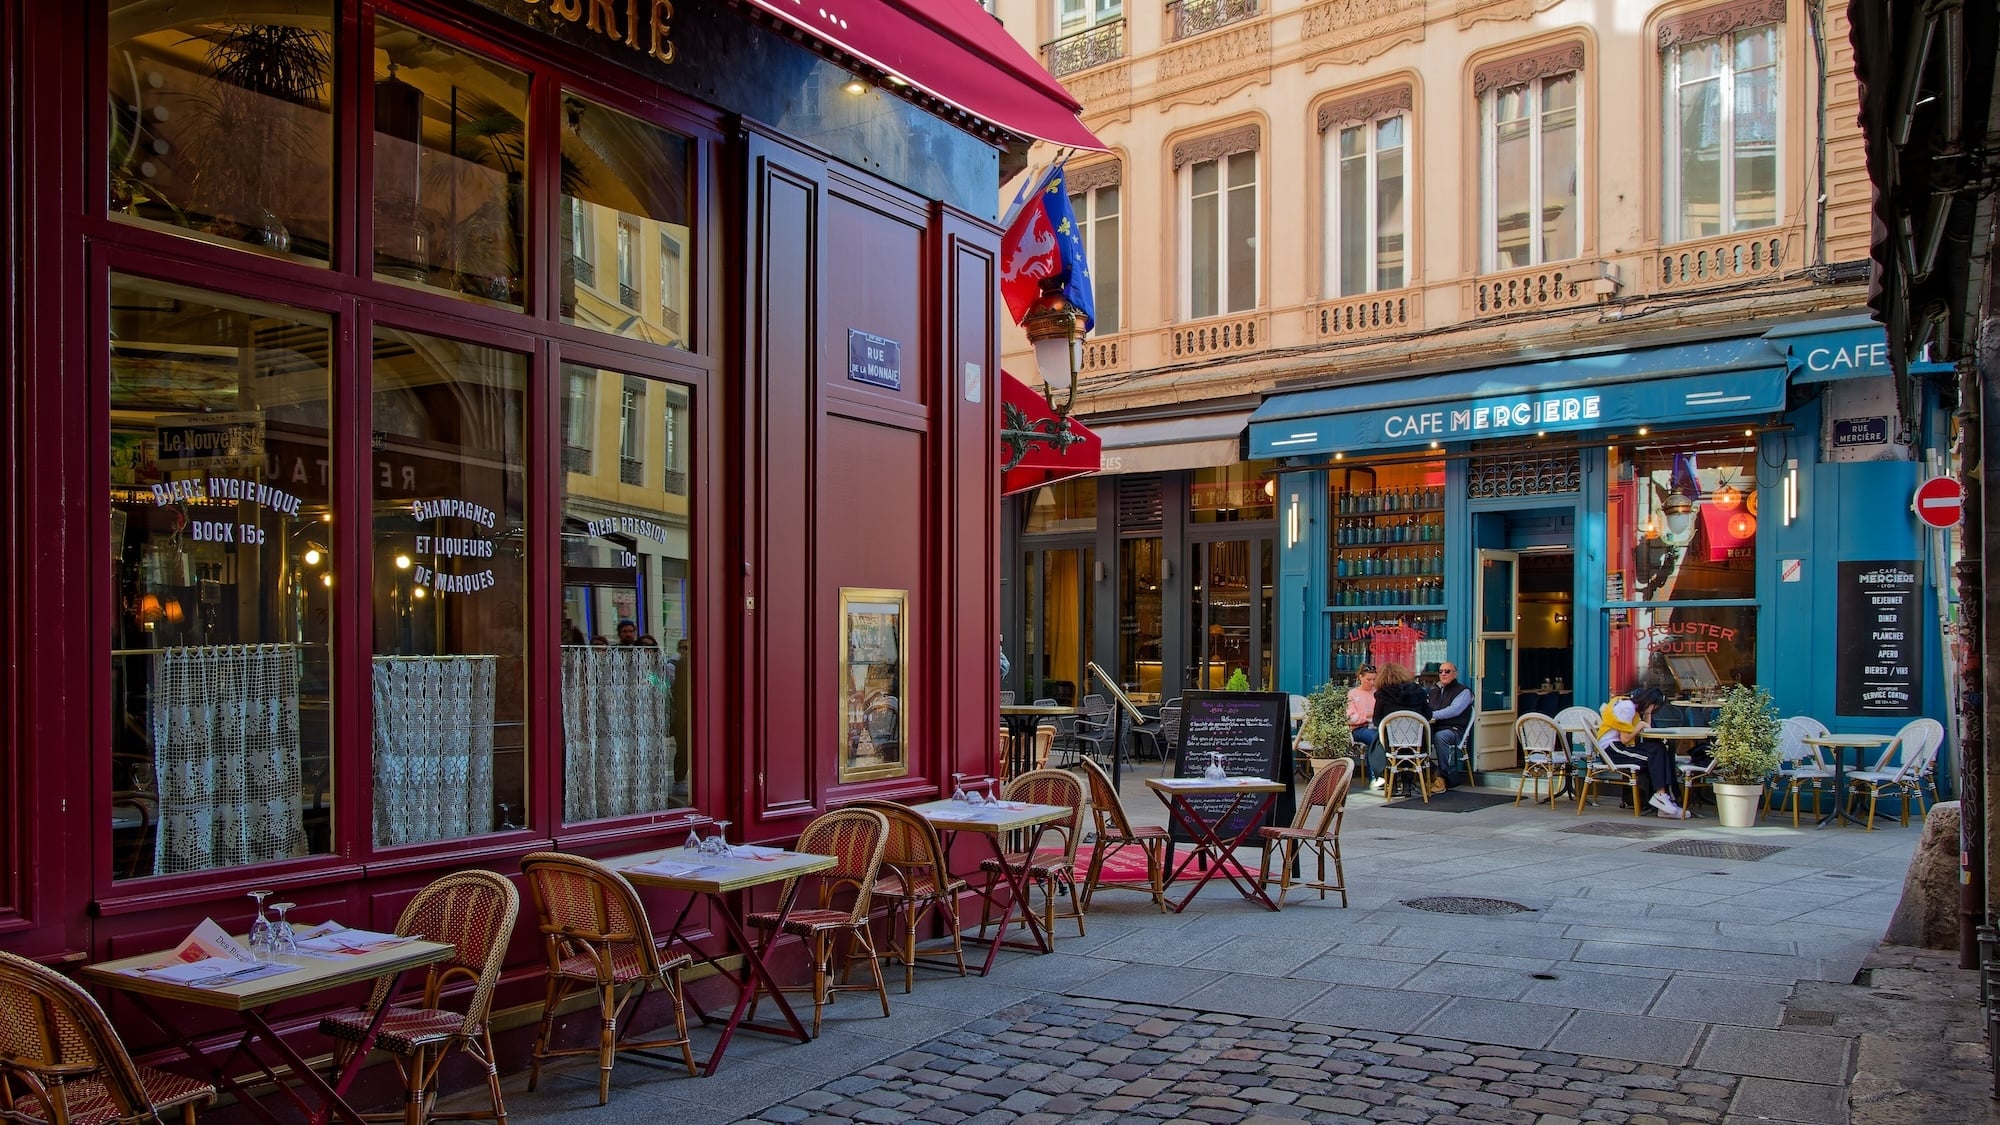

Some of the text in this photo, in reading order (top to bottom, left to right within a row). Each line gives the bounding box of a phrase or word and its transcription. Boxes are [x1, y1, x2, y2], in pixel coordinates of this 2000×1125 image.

[867, 346, 885, 362] RUE
[1807, 342, 1886, 372] CAFE
[852, 363, 898, 382] DE LA MONNAIE
[1384, 395, 1601, 438] CAFE MERCIERE
[1851, 424, 1868, 433] RUE
[162, 431, 183, 452] Le
[1839, 431, 1881, 443] MERCIÈRE
[151, 477, 302, 518] BIERE HYGIENIQUE
[192, 520, 265, 545] BOCK 15c
[587, 517, 668, 544] BIERE PRESSION
[416, 535, 493, 558] ET LIQUEURS
[414, 564, 495, 595] DE MARQUES
[1858, 574, 1915, 584] MERCIERE
[1871, 596, 1903, 605] DEJEUNER
[1878, 614, 1897, 623] DINER
[1872, 631, 1904, 641] PLANCHES
[1877, 650, 1899, 658] APERO
[1864, 666, 1888, 675] BIERES
[1895, 666, 1909, 675] VINS
[1862, 691, 1887, 701] SERVICE
[215, 935, 230, 950] Des
